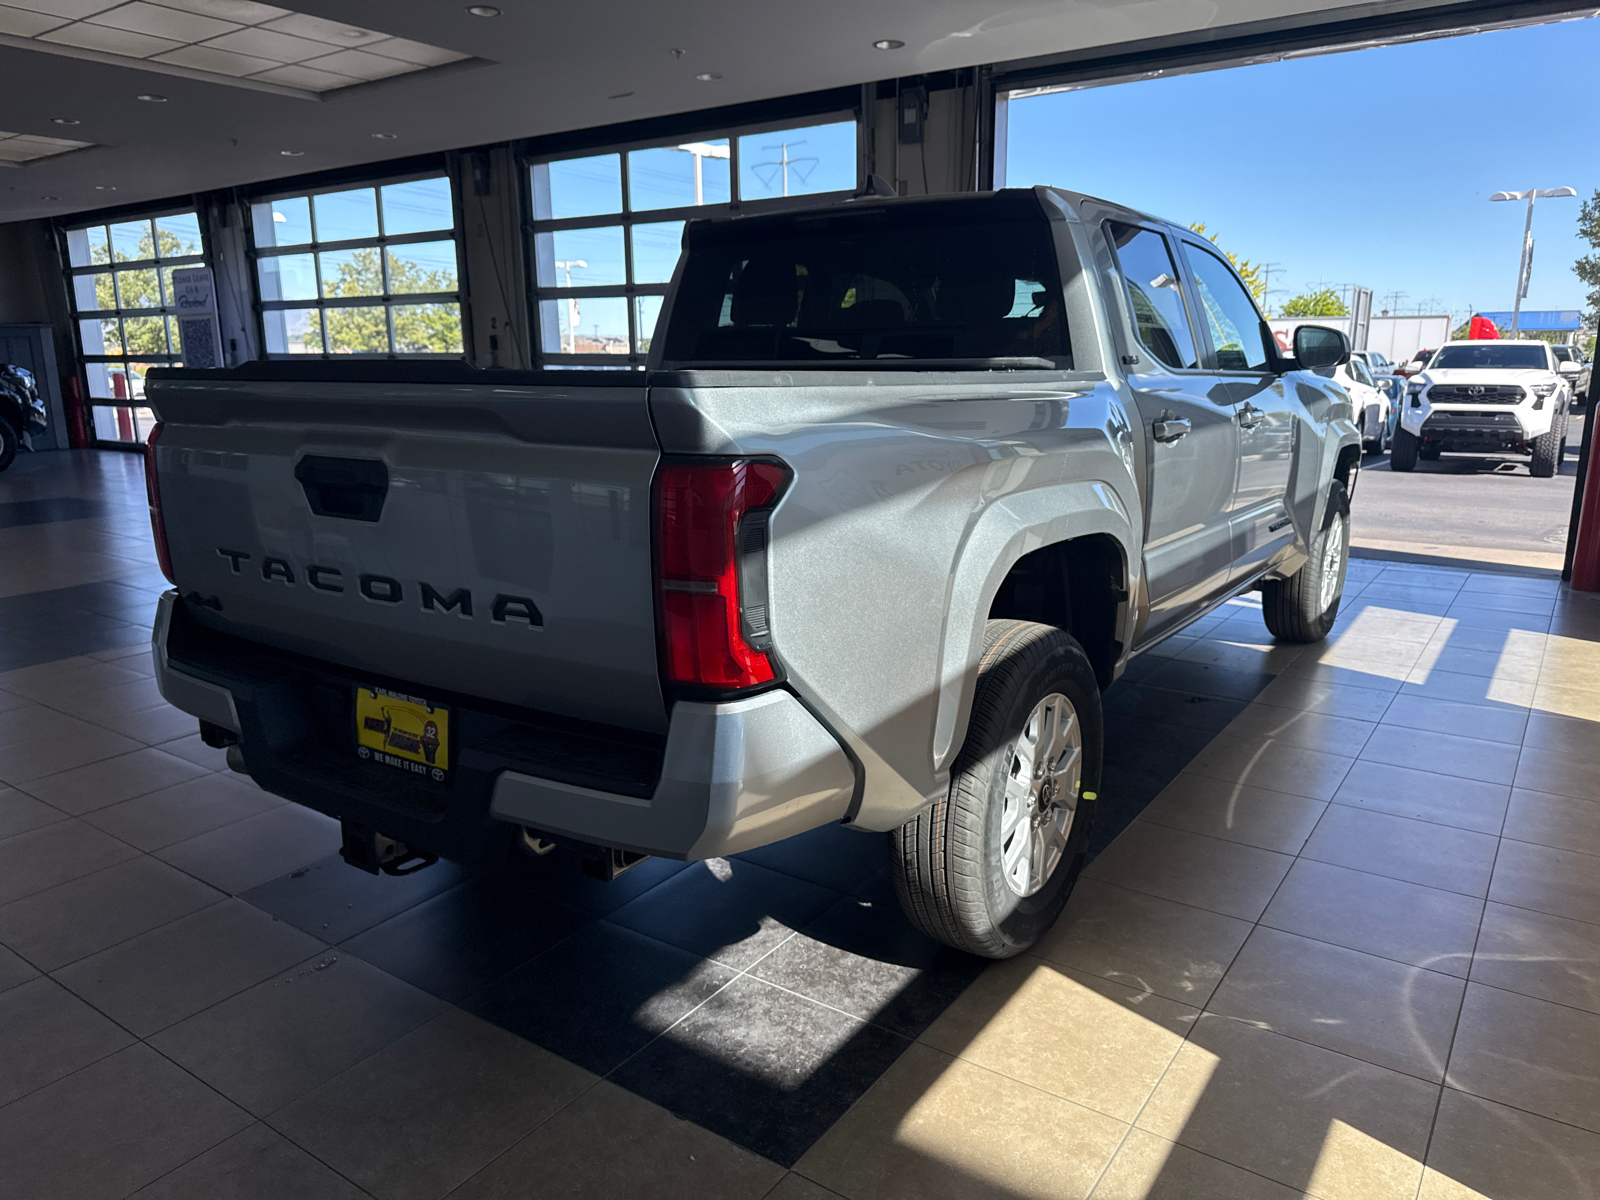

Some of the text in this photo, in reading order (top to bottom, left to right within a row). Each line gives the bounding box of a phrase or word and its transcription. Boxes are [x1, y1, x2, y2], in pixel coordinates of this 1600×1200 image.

[214, 547, 545, 632] TACOMA
[426, 726, 436, 739] 32
[373, 751, 427, 775] WE MAKE IT EASY
